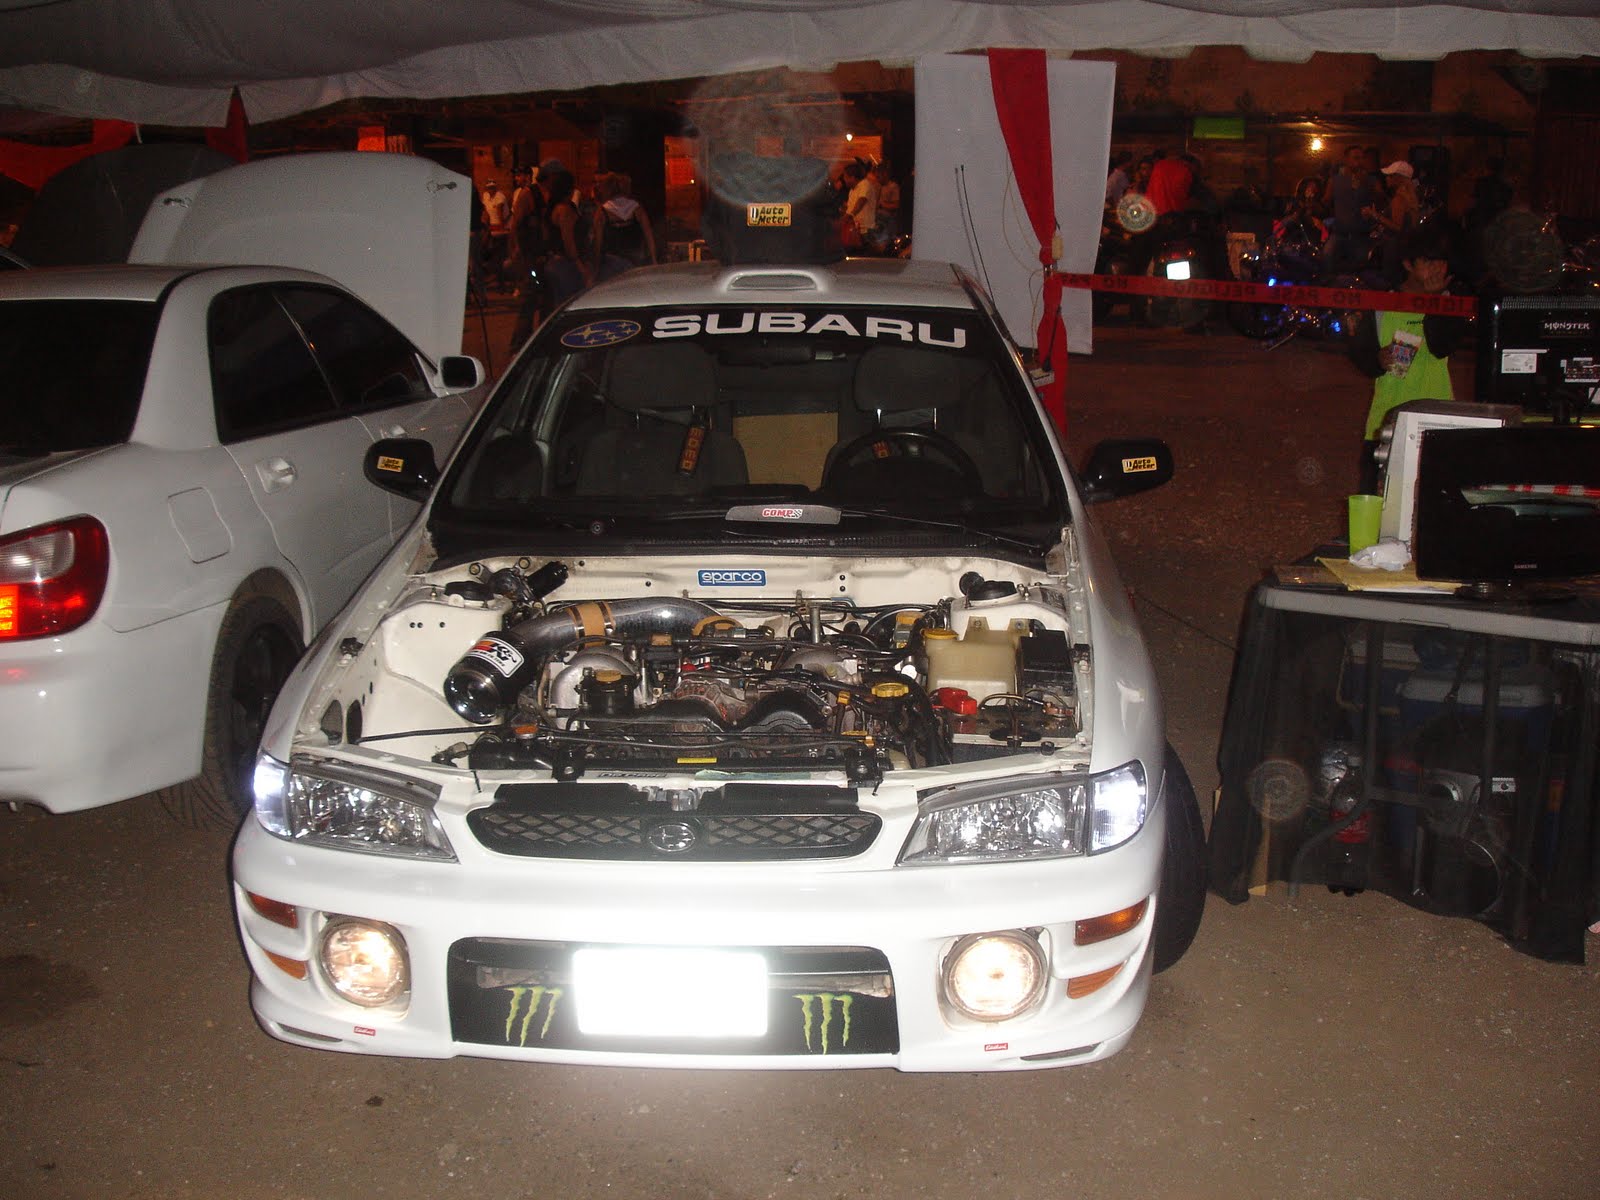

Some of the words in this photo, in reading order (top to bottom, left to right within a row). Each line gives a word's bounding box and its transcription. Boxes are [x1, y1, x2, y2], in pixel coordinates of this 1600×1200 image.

[760, 206, 784, 214] Auto
[758, 215, 788, 224] Meter
[1544, 321, 1590, 330] MONSTER
[652, 312, 967, 349] SUBARU
[762, 508, 794, 517] COMP
[701, 571, 762, 585] sparco
